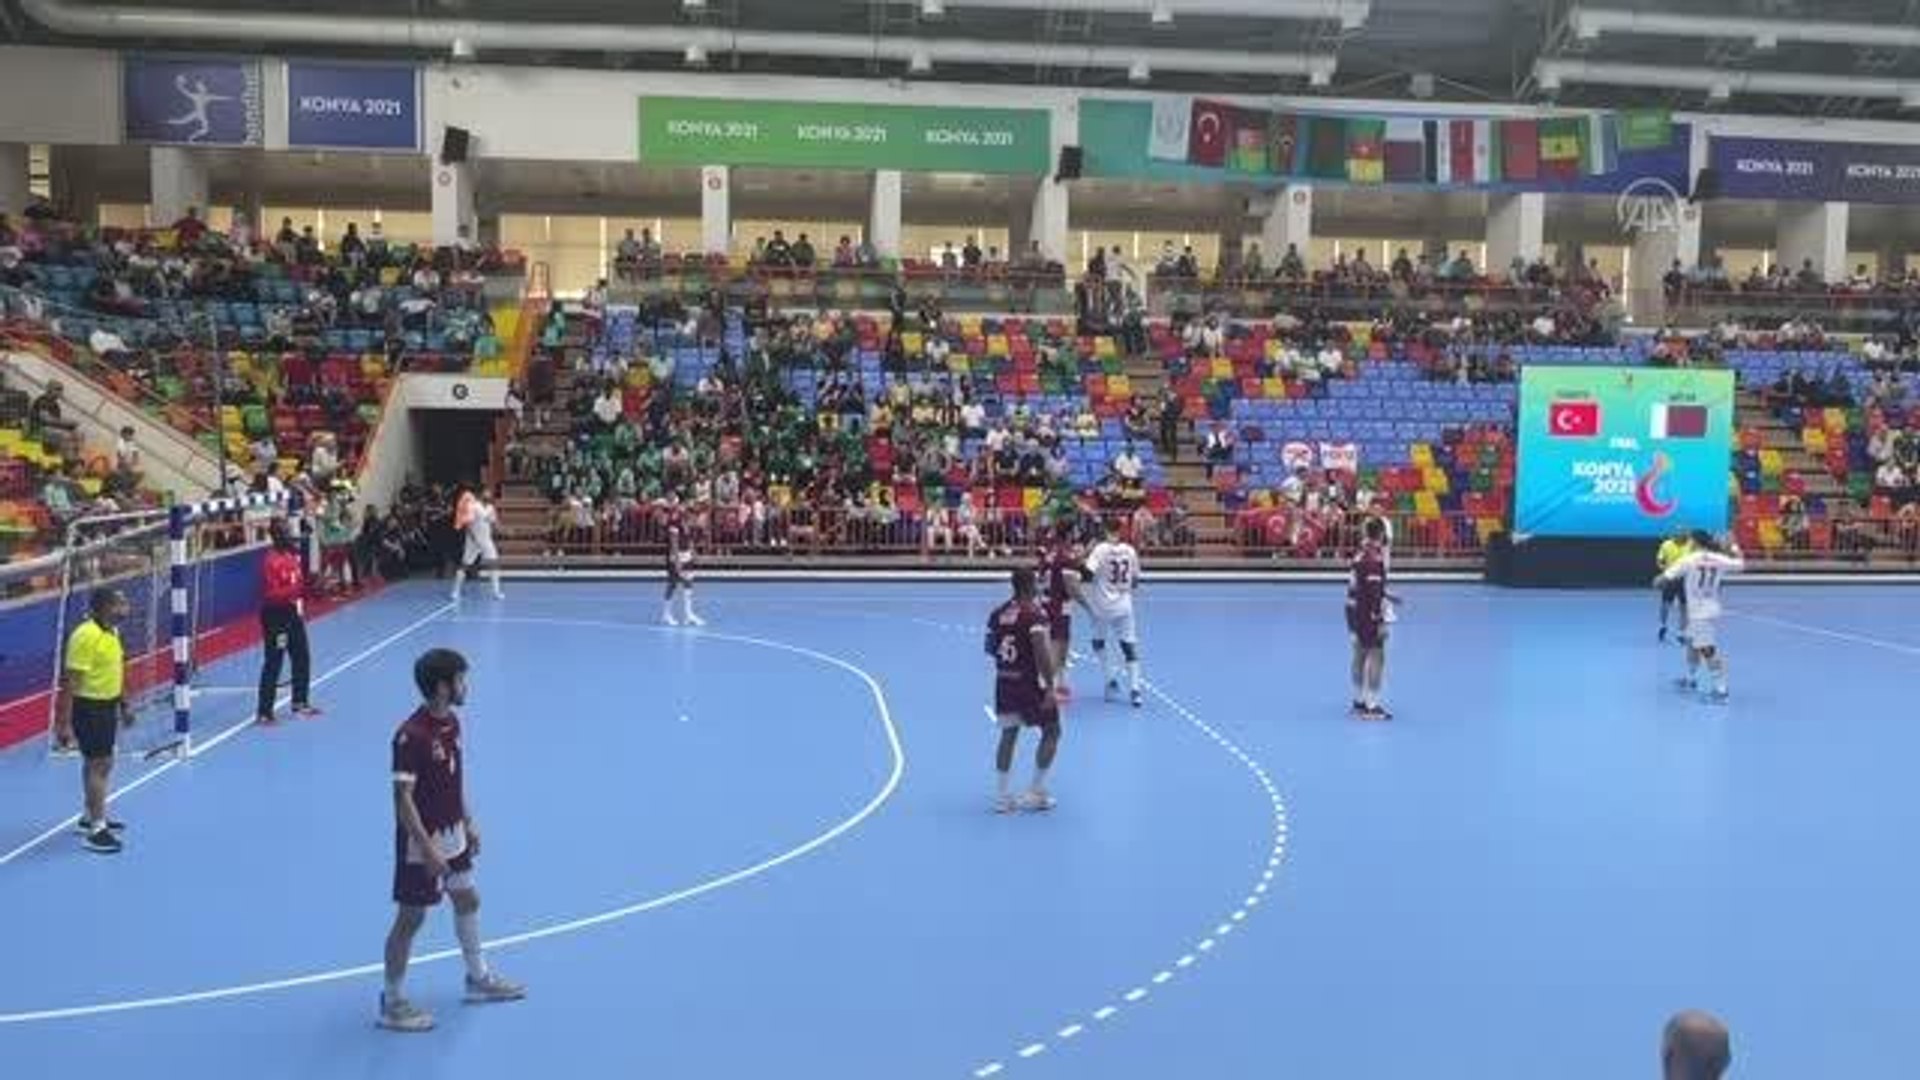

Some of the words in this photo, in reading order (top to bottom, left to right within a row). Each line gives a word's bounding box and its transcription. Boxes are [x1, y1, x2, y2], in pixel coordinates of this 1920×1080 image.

[299, 97, 361, 114] KONYA
[363, 99, 402, 116] 2021
[668, 120, 721, 137] KONYA
[925, 128, 978, 145] KONYA
[1736, 158, 1783, 174] KONYA
[452, 383, 470, 400] G
[1572, 460, 1634, 478] KONYA
[1593, 479, 1637, 494] 2021
[1109, 560, 1130, 584] 32
